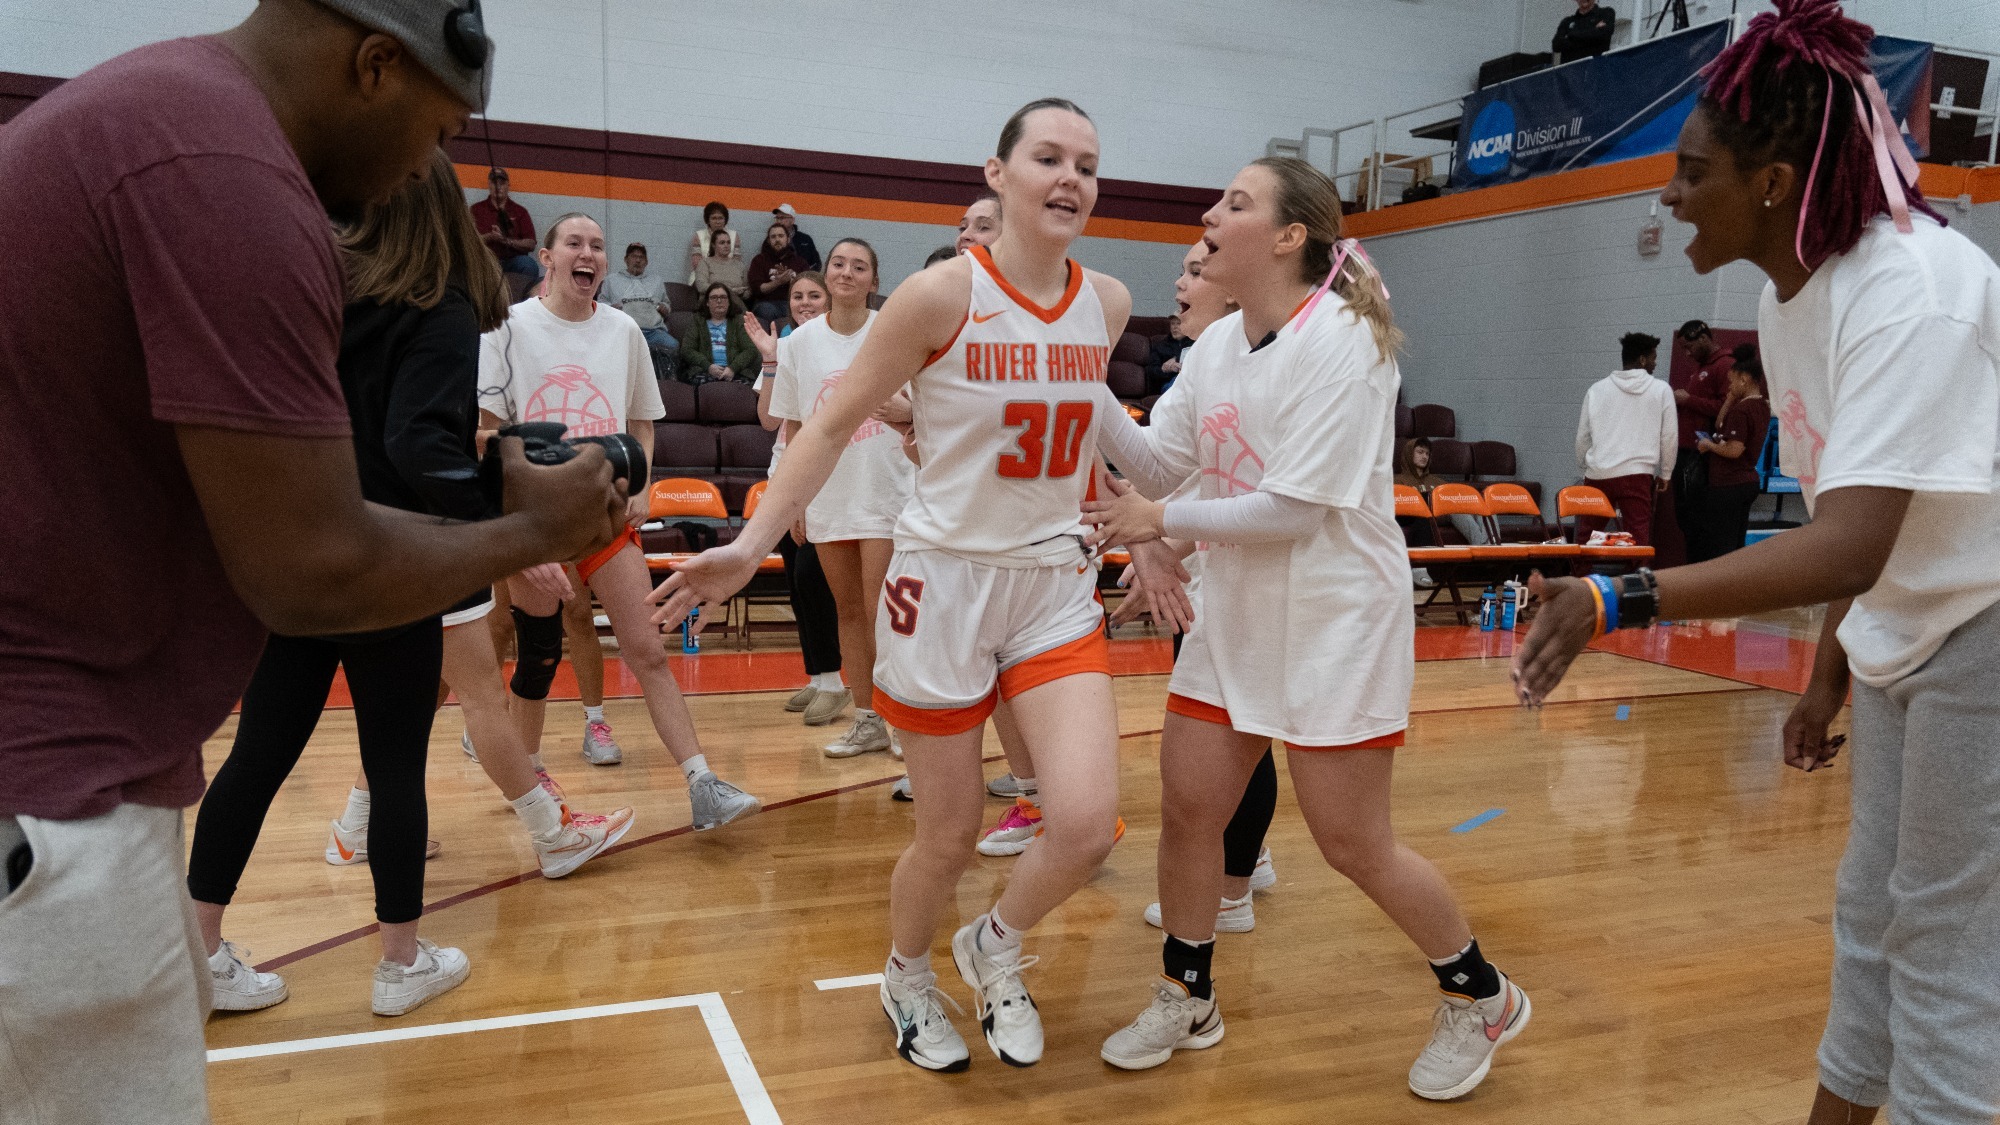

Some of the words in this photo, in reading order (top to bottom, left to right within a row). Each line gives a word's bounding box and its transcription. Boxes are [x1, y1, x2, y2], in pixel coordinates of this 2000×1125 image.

[1468, 133, 1512, 160] NCAA
[1517, 124, 1567, 150] Division
[1570, 117, 1583, 137] III
[966, 342, 1037, 382] RIVER
[997, 400, 1094, 479] 30
[655, 489, 713, 502] Susquehanna
